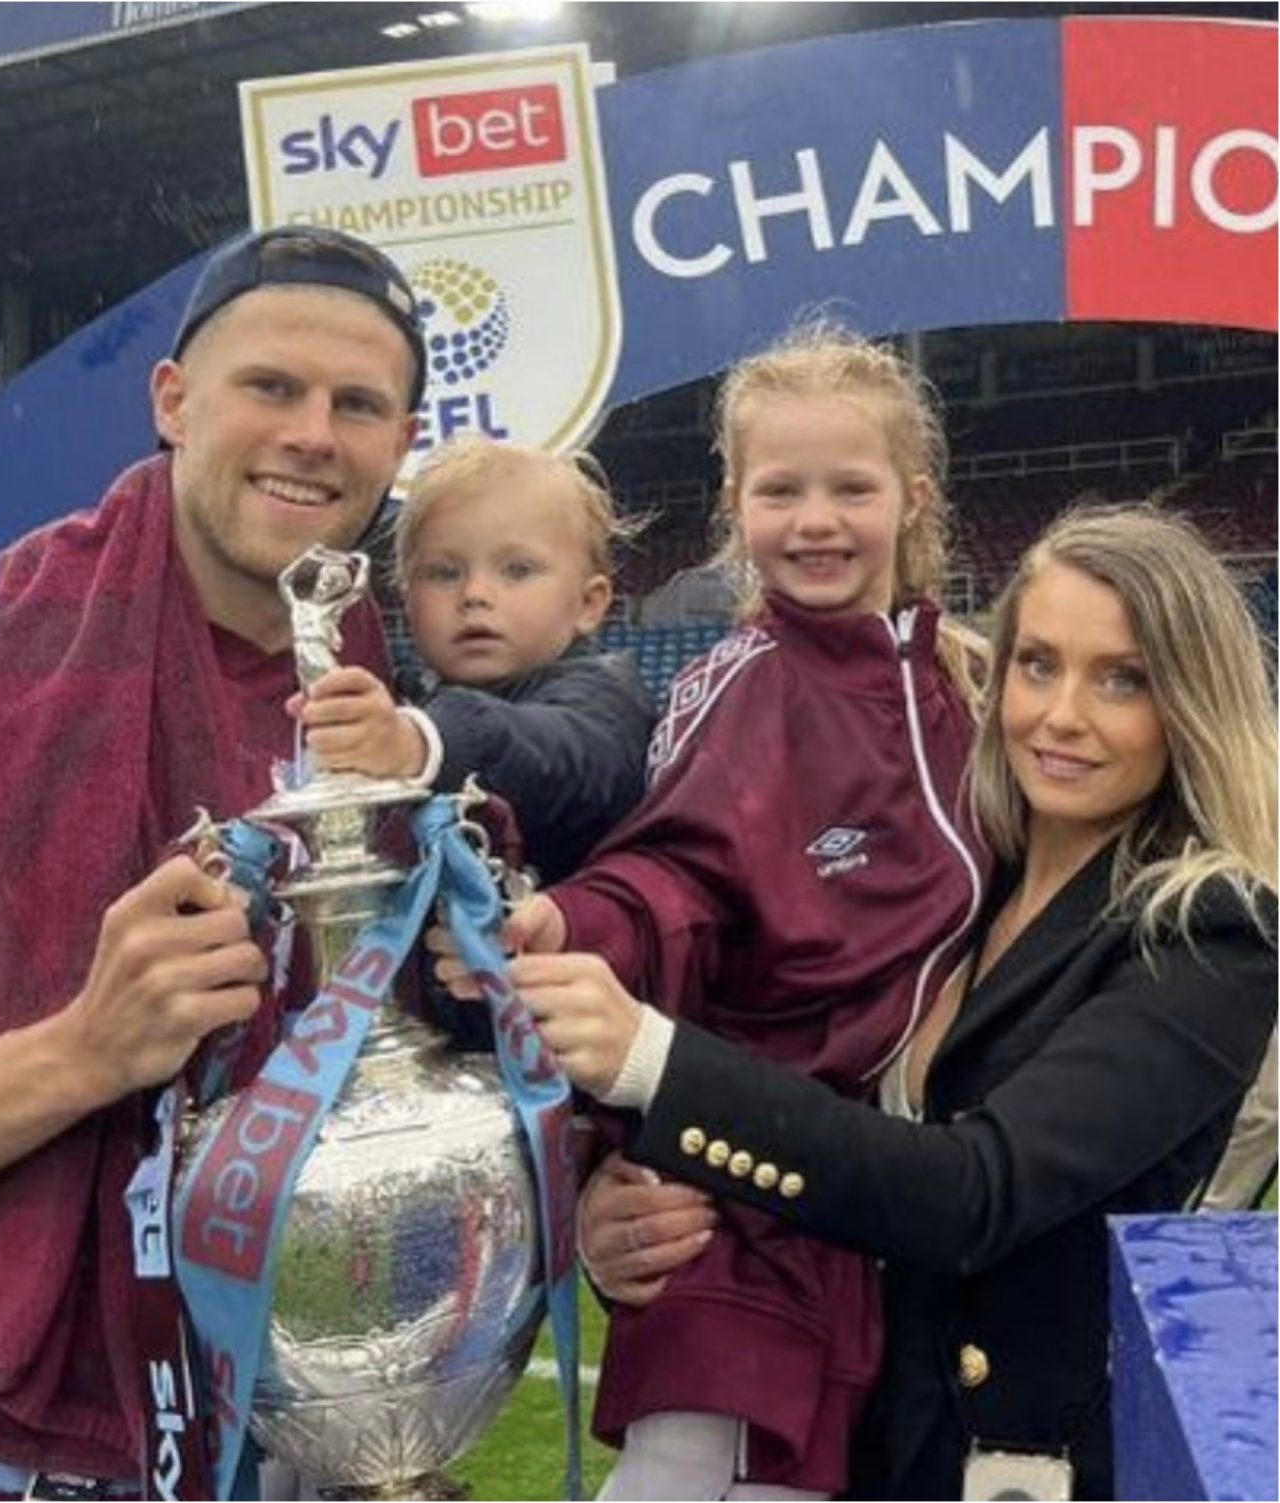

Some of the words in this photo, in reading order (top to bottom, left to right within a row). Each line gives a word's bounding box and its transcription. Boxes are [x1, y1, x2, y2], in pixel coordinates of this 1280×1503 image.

[281, 115, 402, 178] sky
[429, 98, 550, 156] bet
[289, 180, 573, 232] CHAMPIONSHIP
[632, 125, 1278, 278] CHAMPIO
